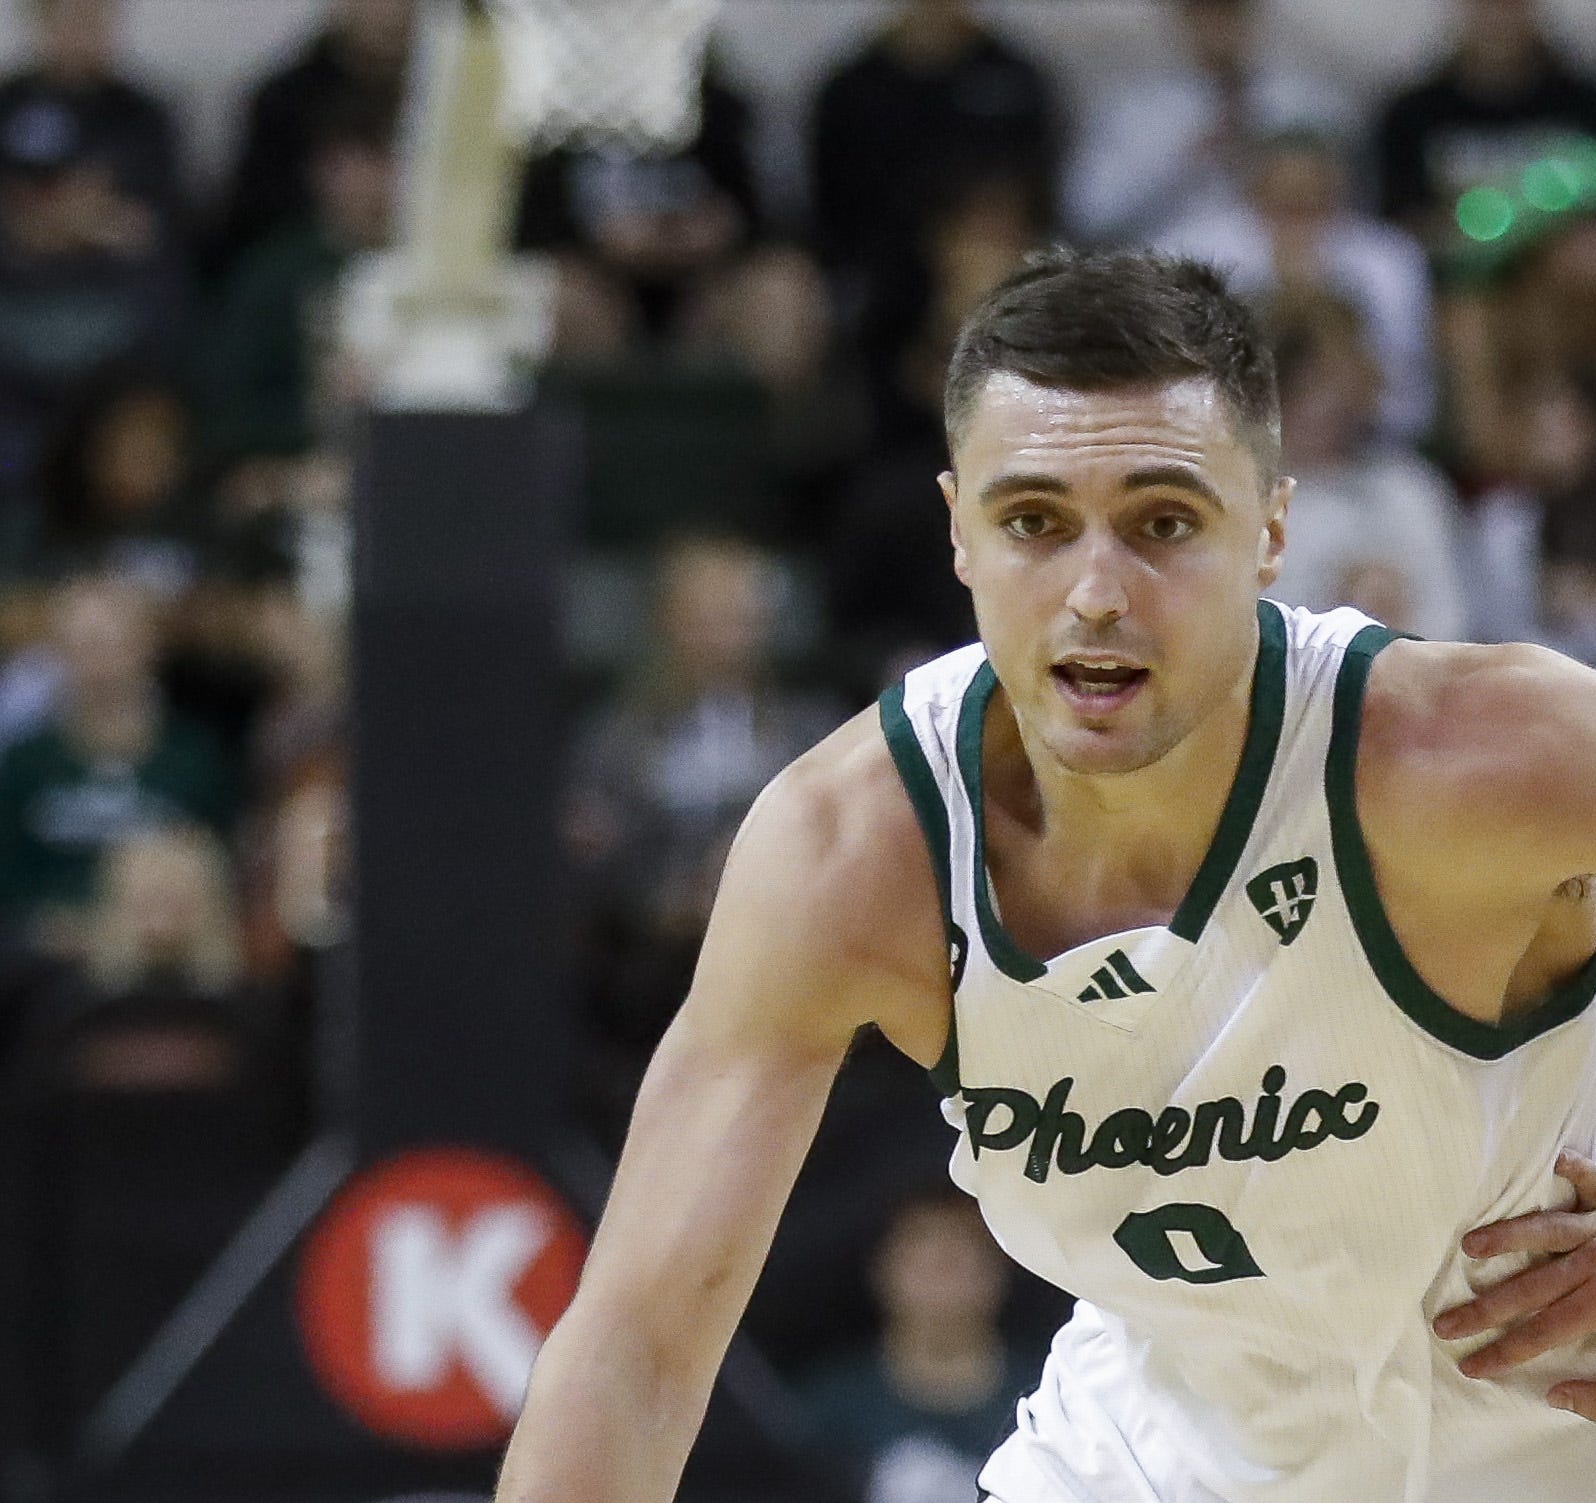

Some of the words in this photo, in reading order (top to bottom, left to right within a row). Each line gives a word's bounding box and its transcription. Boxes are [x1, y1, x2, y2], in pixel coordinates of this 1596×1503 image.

[961, 1065, 1380, 1184] Phoenix
[1112, 1202, 1267, 1285] 0
[365, 1200, 565, 1415] K
